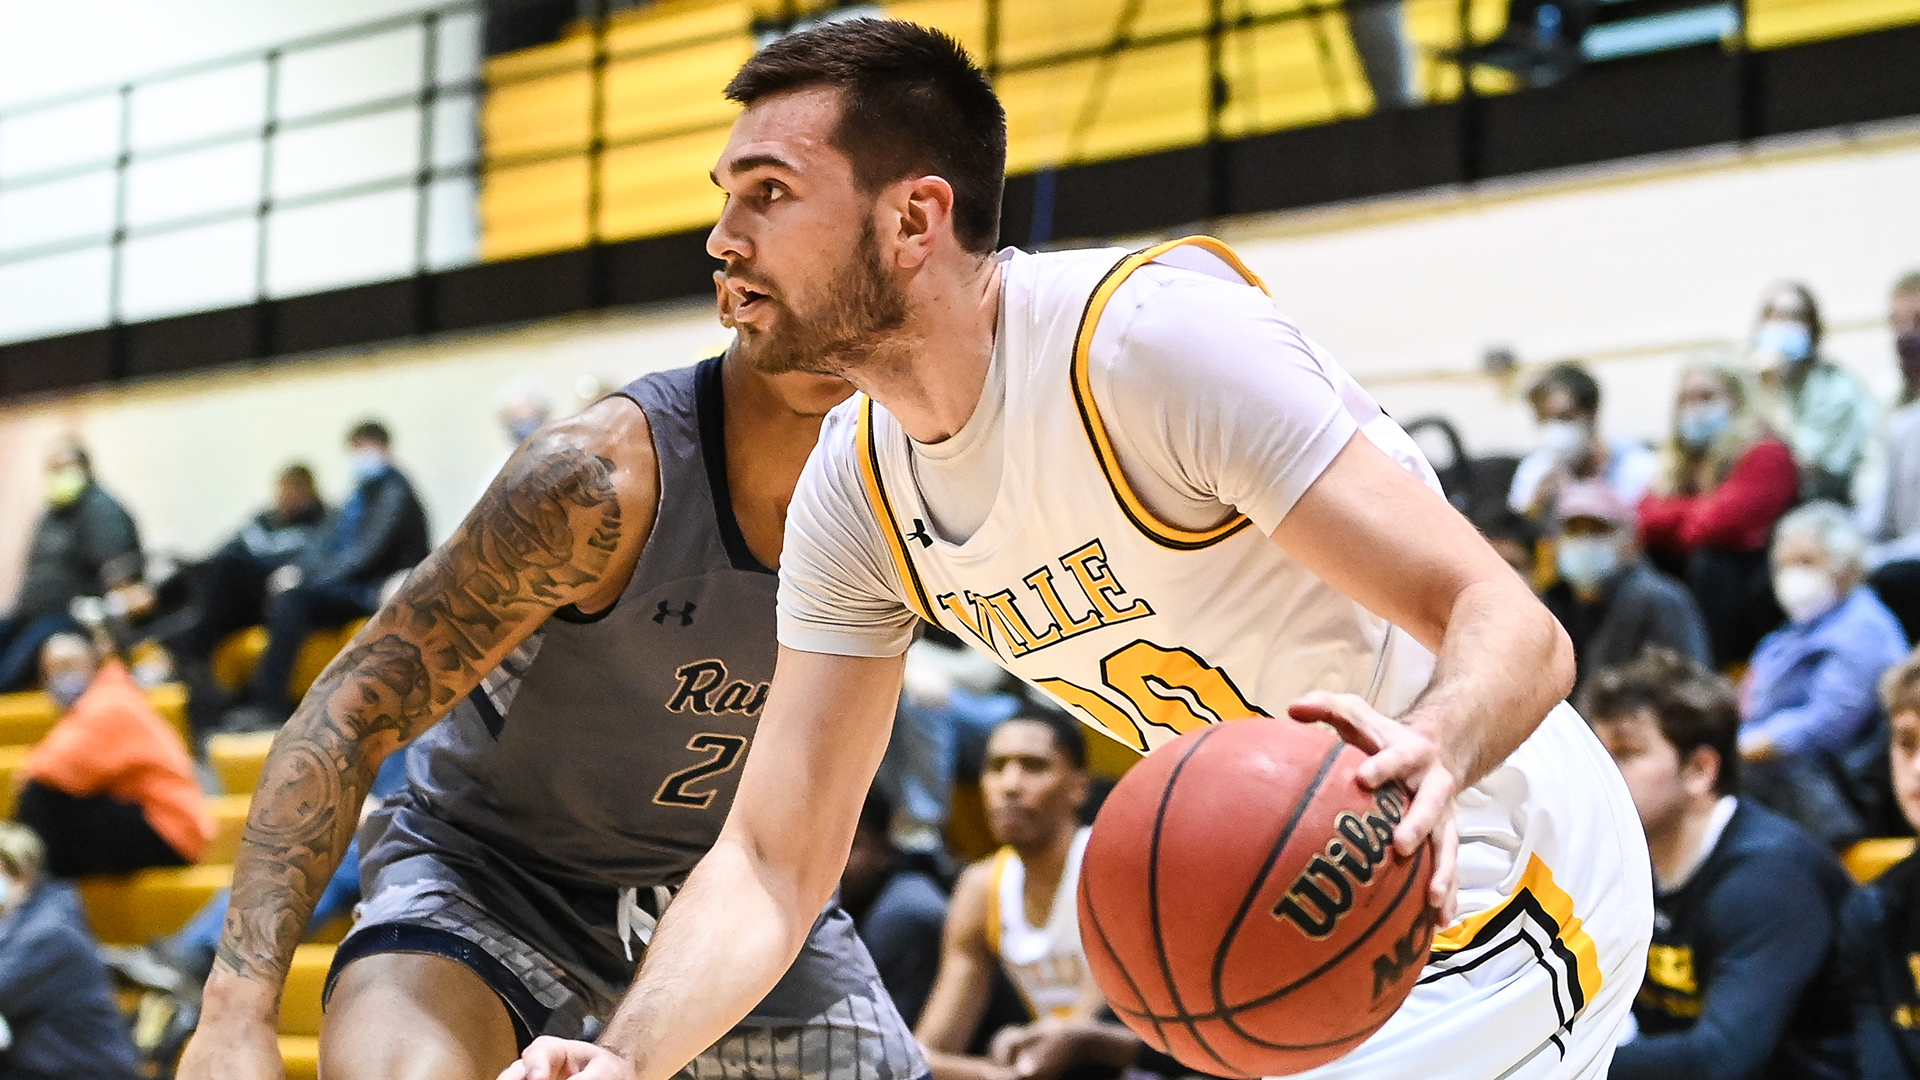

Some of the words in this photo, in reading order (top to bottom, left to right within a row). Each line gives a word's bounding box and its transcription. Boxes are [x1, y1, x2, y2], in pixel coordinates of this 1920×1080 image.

[936, 537, 1157, 664] VILLE
[652, 732, 748, 809] 2
[1269, 779, 1404, 942] Wilso
